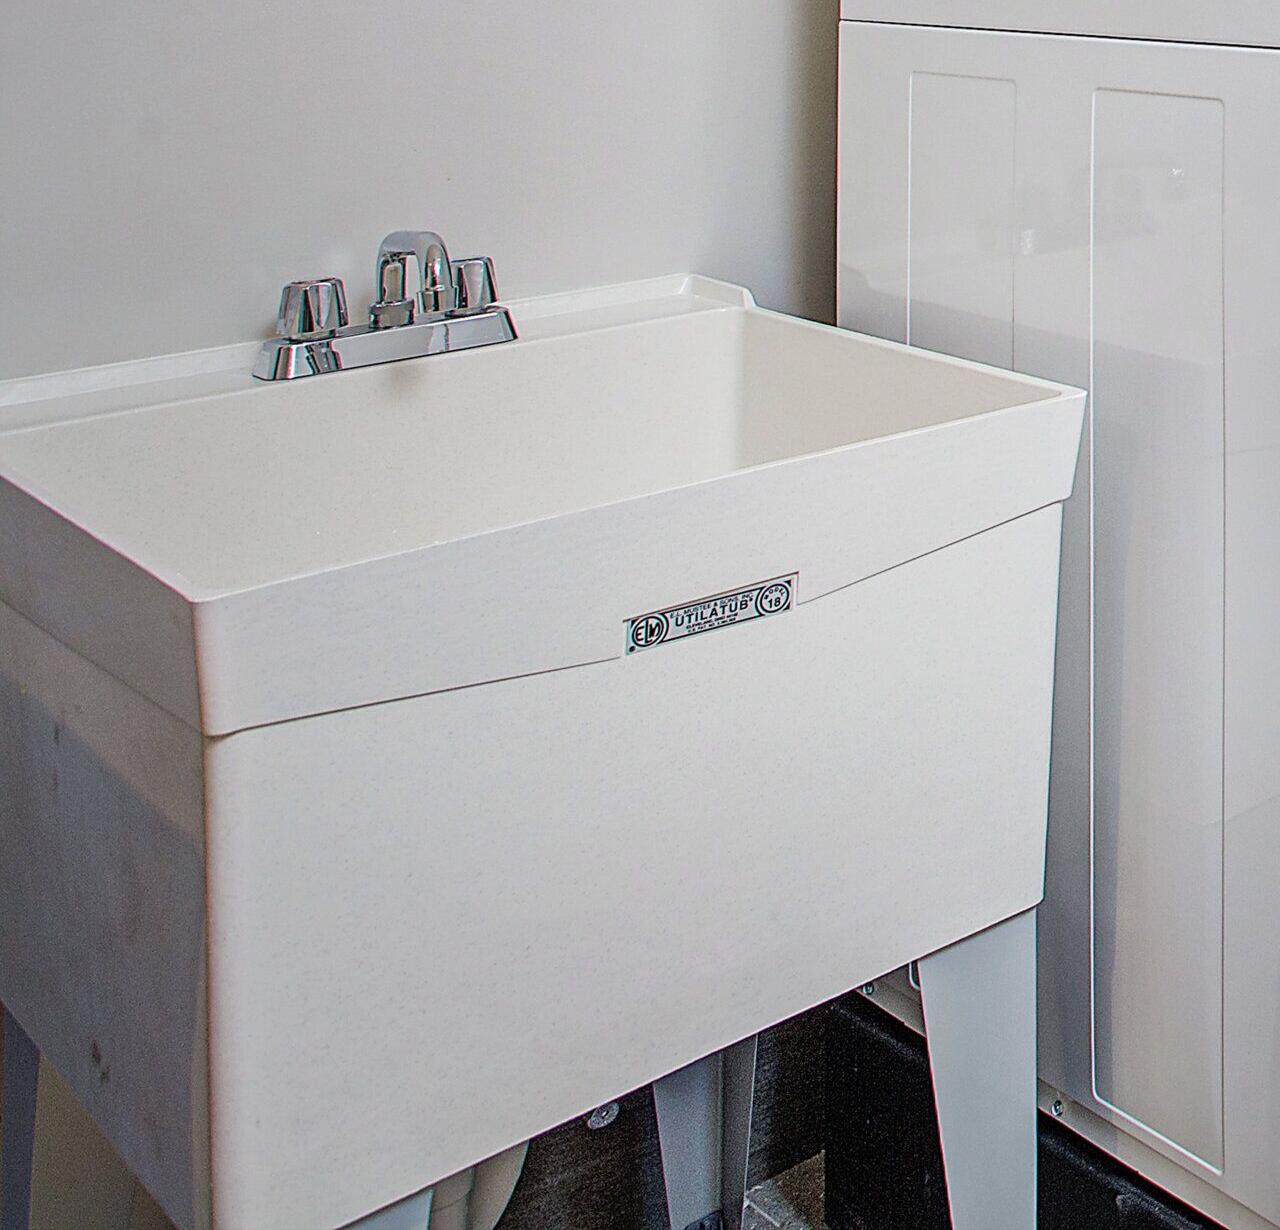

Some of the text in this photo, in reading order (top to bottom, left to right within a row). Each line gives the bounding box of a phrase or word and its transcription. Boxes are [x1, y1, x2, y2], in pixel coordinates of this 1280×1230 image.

[764, 586, 785, 600] MODEL
[684, 601, 711, 615] MUSTEE
[768, 597, 781, 608] 18
[675, 599, 749, 627] UTILATUB
